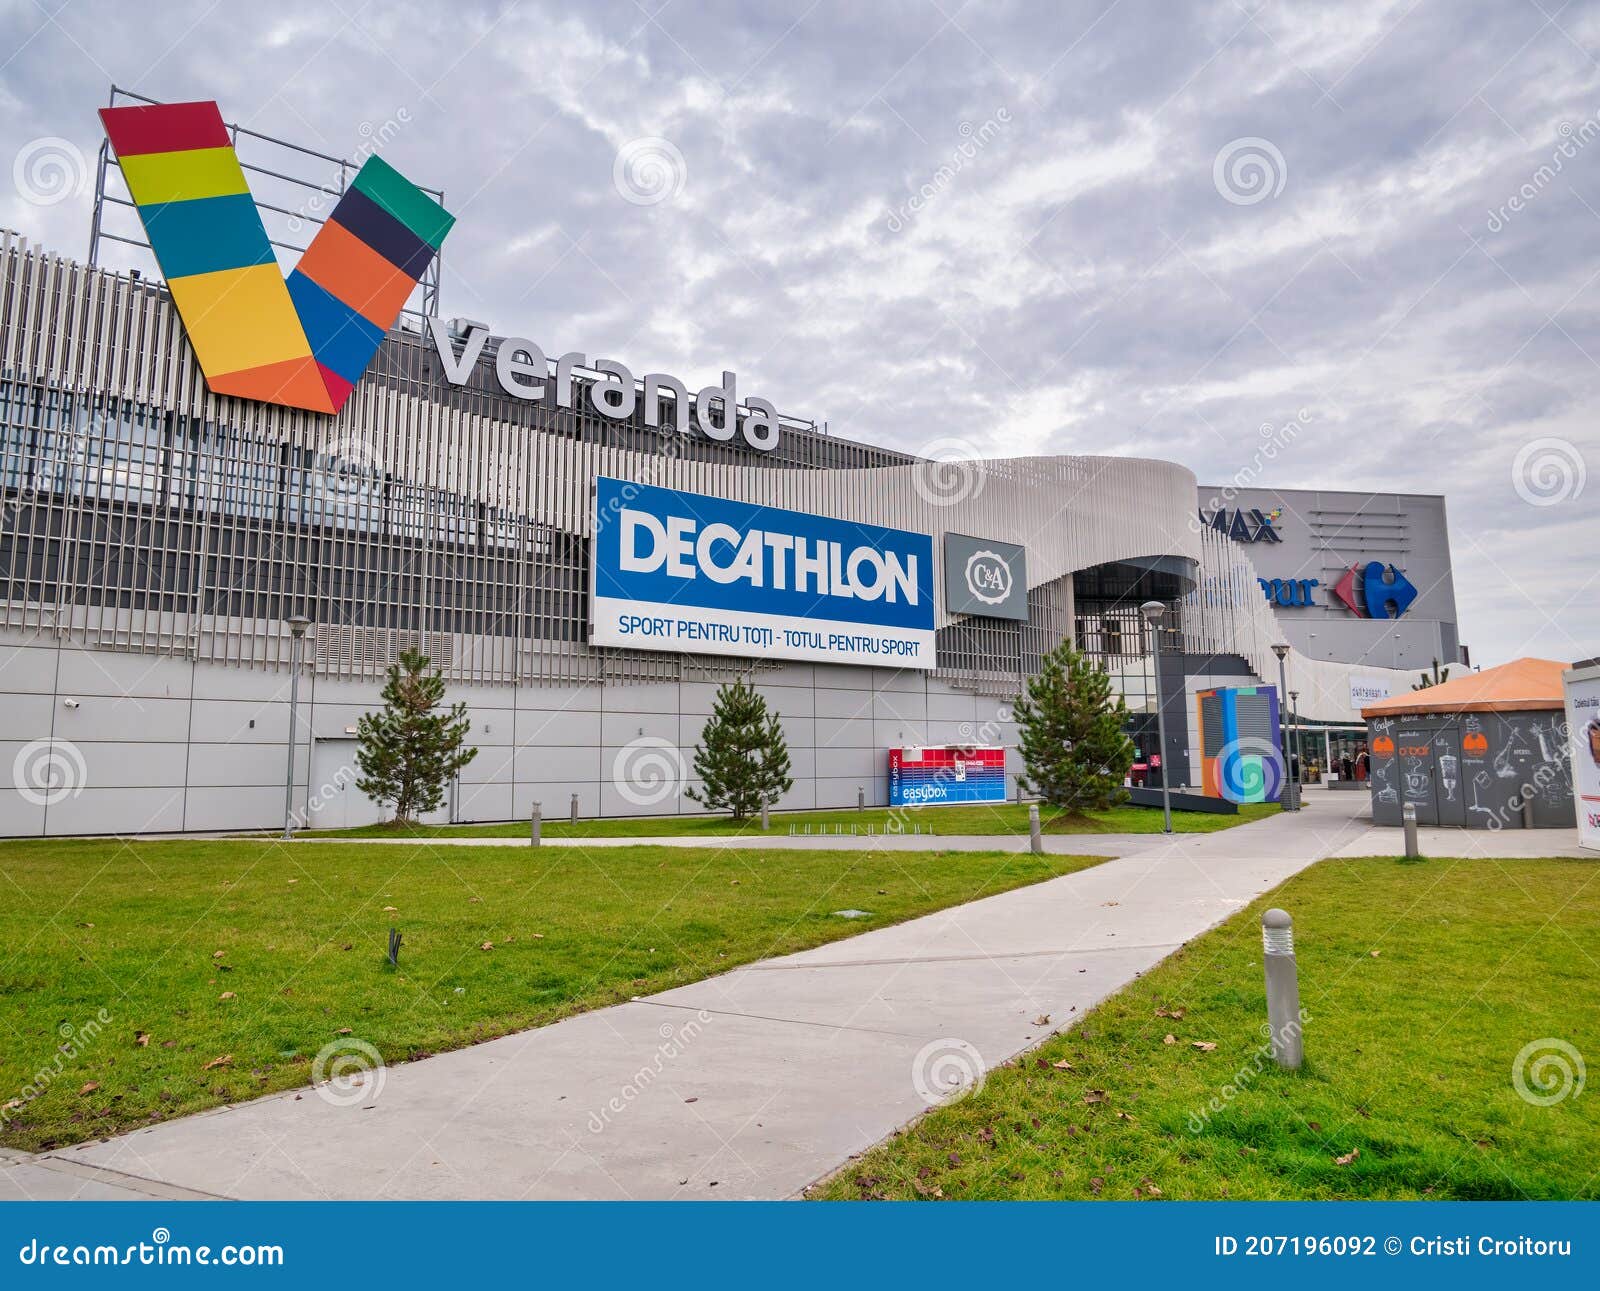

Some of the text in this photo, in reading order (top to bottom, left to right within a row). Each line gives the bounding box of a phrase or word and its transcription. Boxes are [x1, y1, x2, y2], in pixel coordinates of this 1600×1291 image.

[425, 315, 780, 452] veranda
[619, 508, 919, 606] DECATHLON
[973, 563, 1005, 590] C&A
[619, 615, 675, 638] SPORT
[677, 620, 740, 643] PENTRU
[784, 630, 827, 650] TOTUL
[829, 635, 879, 654] PENTRU
[882, 640, 920, 657] SPORT
[903, 785, 947, 801] easybox
